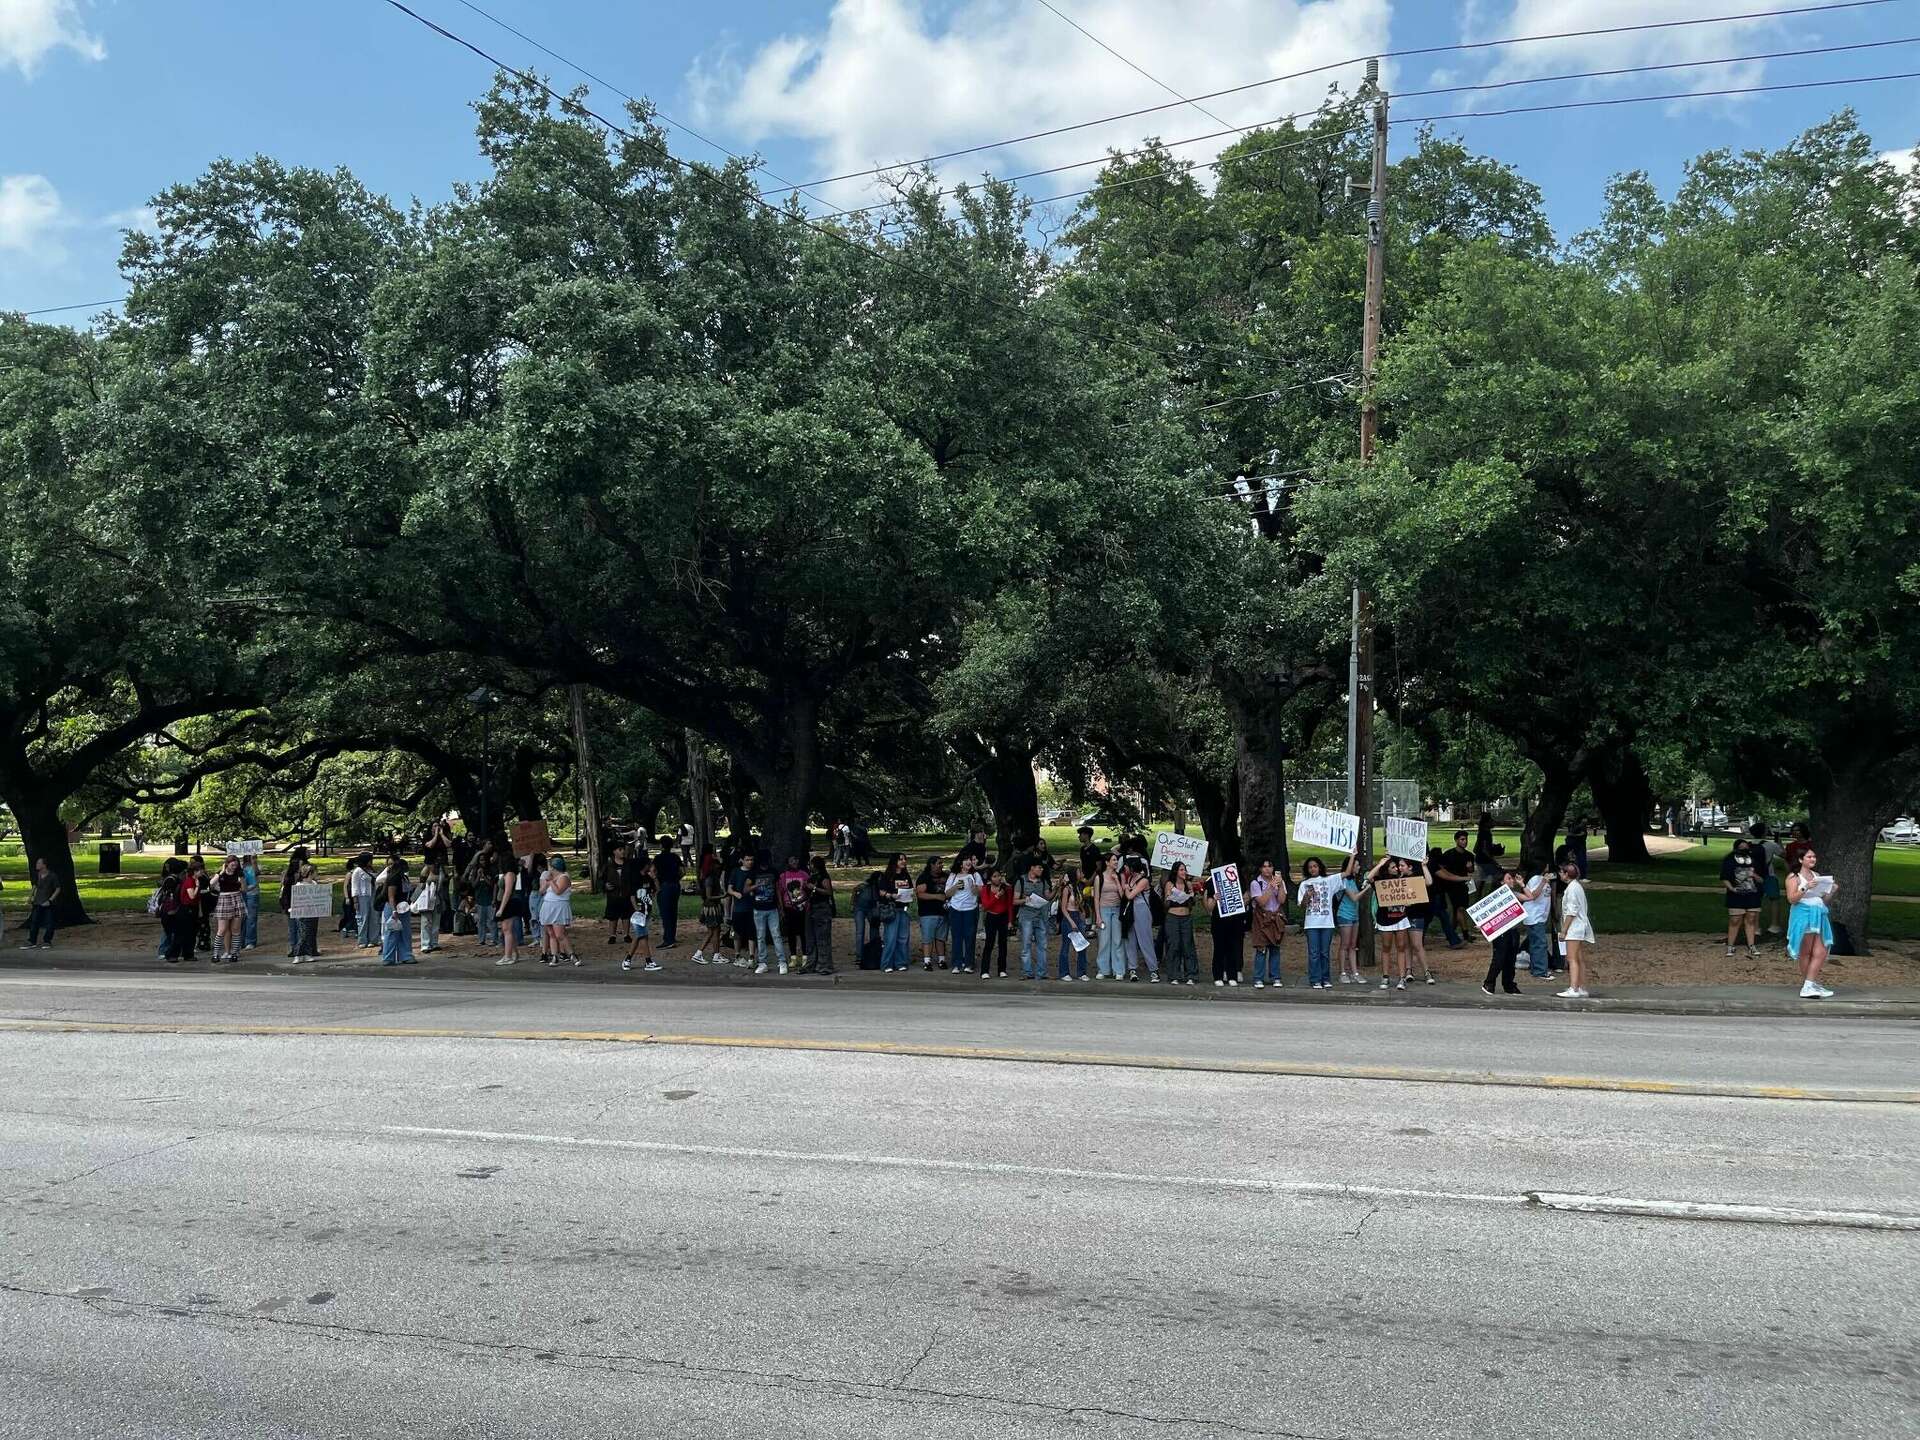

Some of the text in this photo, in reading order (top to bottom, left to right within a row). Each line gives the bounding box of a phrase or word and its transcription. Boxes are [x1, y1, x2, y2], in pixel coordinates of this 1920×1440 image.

[1324, 810, 1353, 829] Miles
[1158, 832, 1203, 851] Our Staff
[1330, 826, 1357, 849] HISD
[1160, 845, 1196, 860] Deserves
[1160, 855, 1191, 867] Ber
[1381, 879, 1407, 889] SAVE
[1379, 891, 1417, 902] SCHOOLS
